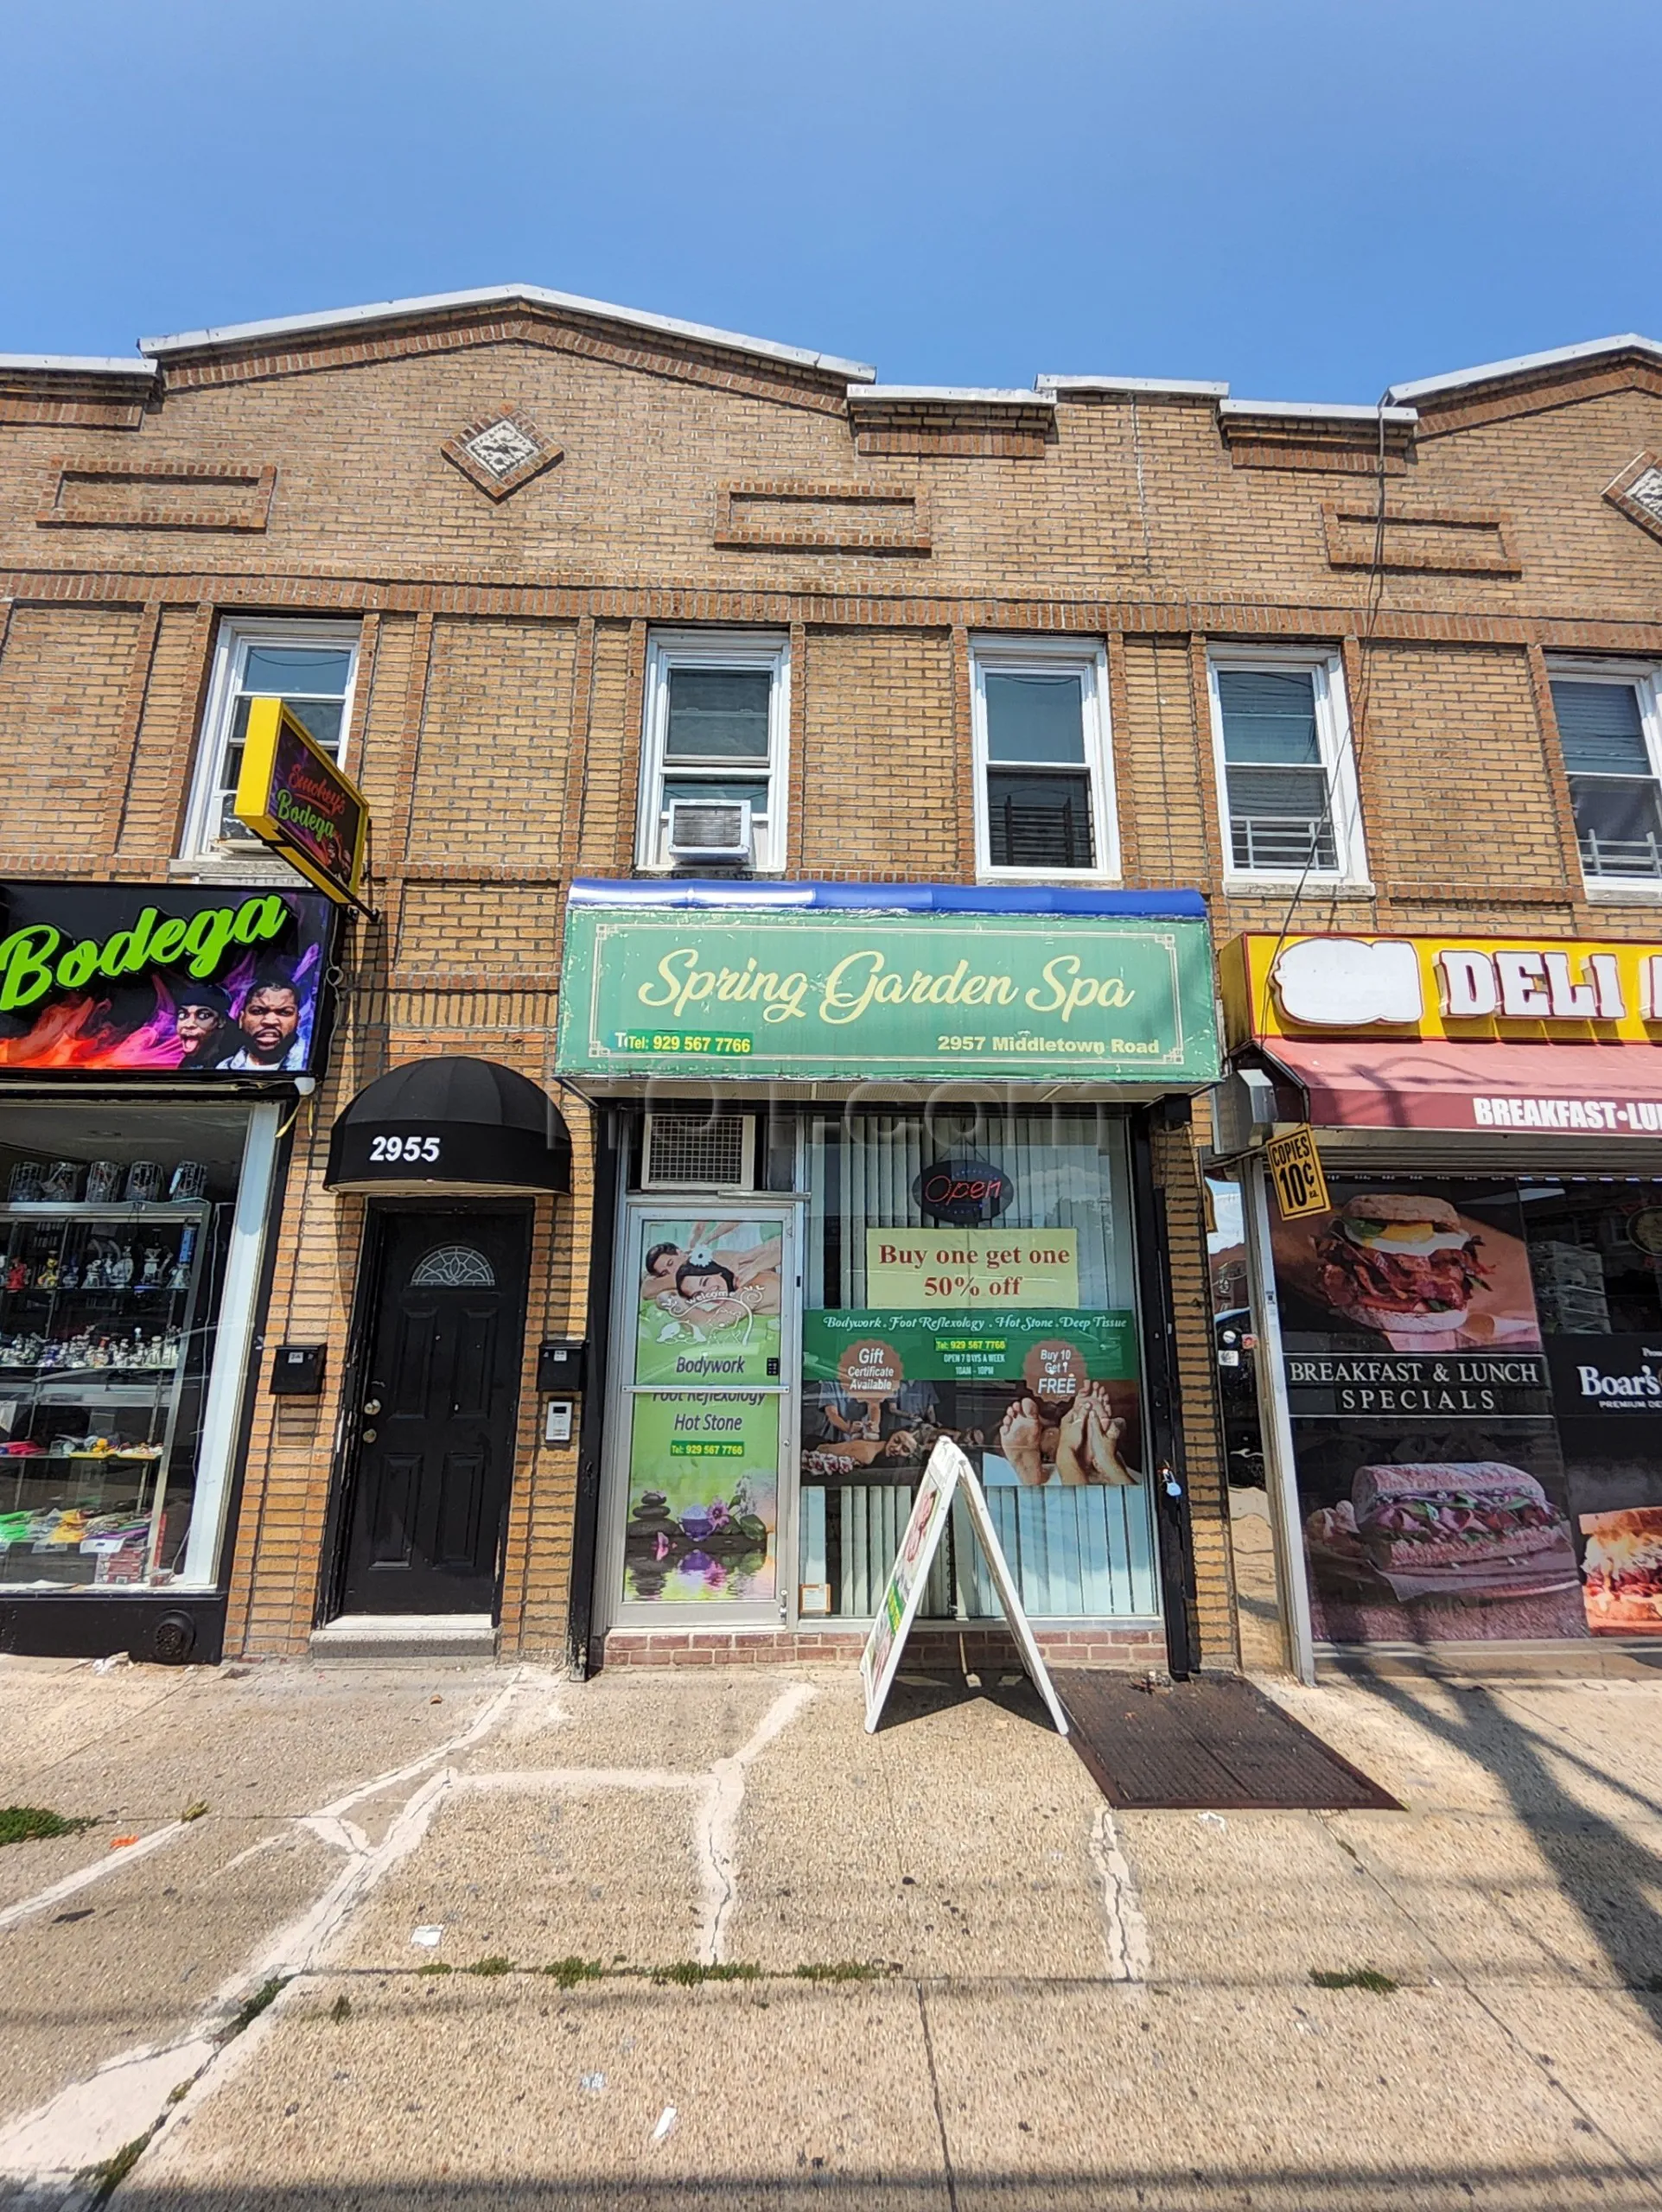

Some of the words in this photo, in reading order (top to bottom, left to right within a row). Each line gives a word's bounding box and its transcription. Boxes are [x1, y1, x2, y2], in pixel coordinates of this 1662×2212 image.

[277, 789, 335, 842] Bodega
[0, 895, 287, 1010] Bodega
[638, 948, 809, 1023] Spring
[819, 950, 1020, 1024] Garden
[1025, 954, 1136, 1023] Spa
[1435, 950, 1627, 1020] DELI
[653, 1035, 680, 1051] 929
[684, 1036, 710, 1052] 567
[715, 1037, 751, 1053] 7766
[938, 1036, 985, 1051] 2957
[992, 1036, 1105, 1053] Middletown
[1111, 1039, 1160, 1054] Road
[369, 1135, 440, 1162] 2955
[1271, 1135, 1310, 1167] COPIES
[925, 1175, 1002, 1205] Open
[1279, 1160, 1315, 1209] 10¢
[878, 1244, 927, 1268] Buy
[936, 1249, 978, 1263] one
[986, 1246, 1022, 1269] get
[1028, 1249, 1070, 1264] one
[924, 1276, 979, 1297] 50%
[989, 1275, 1023, 1296] off
[888, 1315, 917, 1331] Foot
[919, 1316, 985, 1332] Reflexology
[995, 1314, 1020, 1328] Hot
[1092, 1315, 1127, 1328] Tissue
[858, 1348, 885, 1364] Gift
[943, 1353, 960, 1363] OPEN
[988, 1354, 1006, 1363] WEEK
[1040, 1350, 1059, 1362] Buy
[1060, 1350, 1071, 1360] 10
[676, 1356, 745, 1376] Bodywork
[848, 1365, 895, 1377] Certificate
[1044, 1363, 1061, 1373] Get
[1289, 1363, 1423, 1382] BREAKFAST
[1433, 1363, 1449, 1382] &
[1458, 1363, 1538, 1382] LUNCH
[850, 1378, 893, 1390] Available
[1038, 1377, 1077, 1394] FREE
[1576, 1364, 1660, 1395] Boar's
[1341, 1389, 1494, 1409] SPECIALS
[674, 1414, 701, 1430] Hot
[703, 1414, 742, 1431] Stone
[685, 1445, 702, 1454] 929
[704, 1446, 719, 1454] 567
